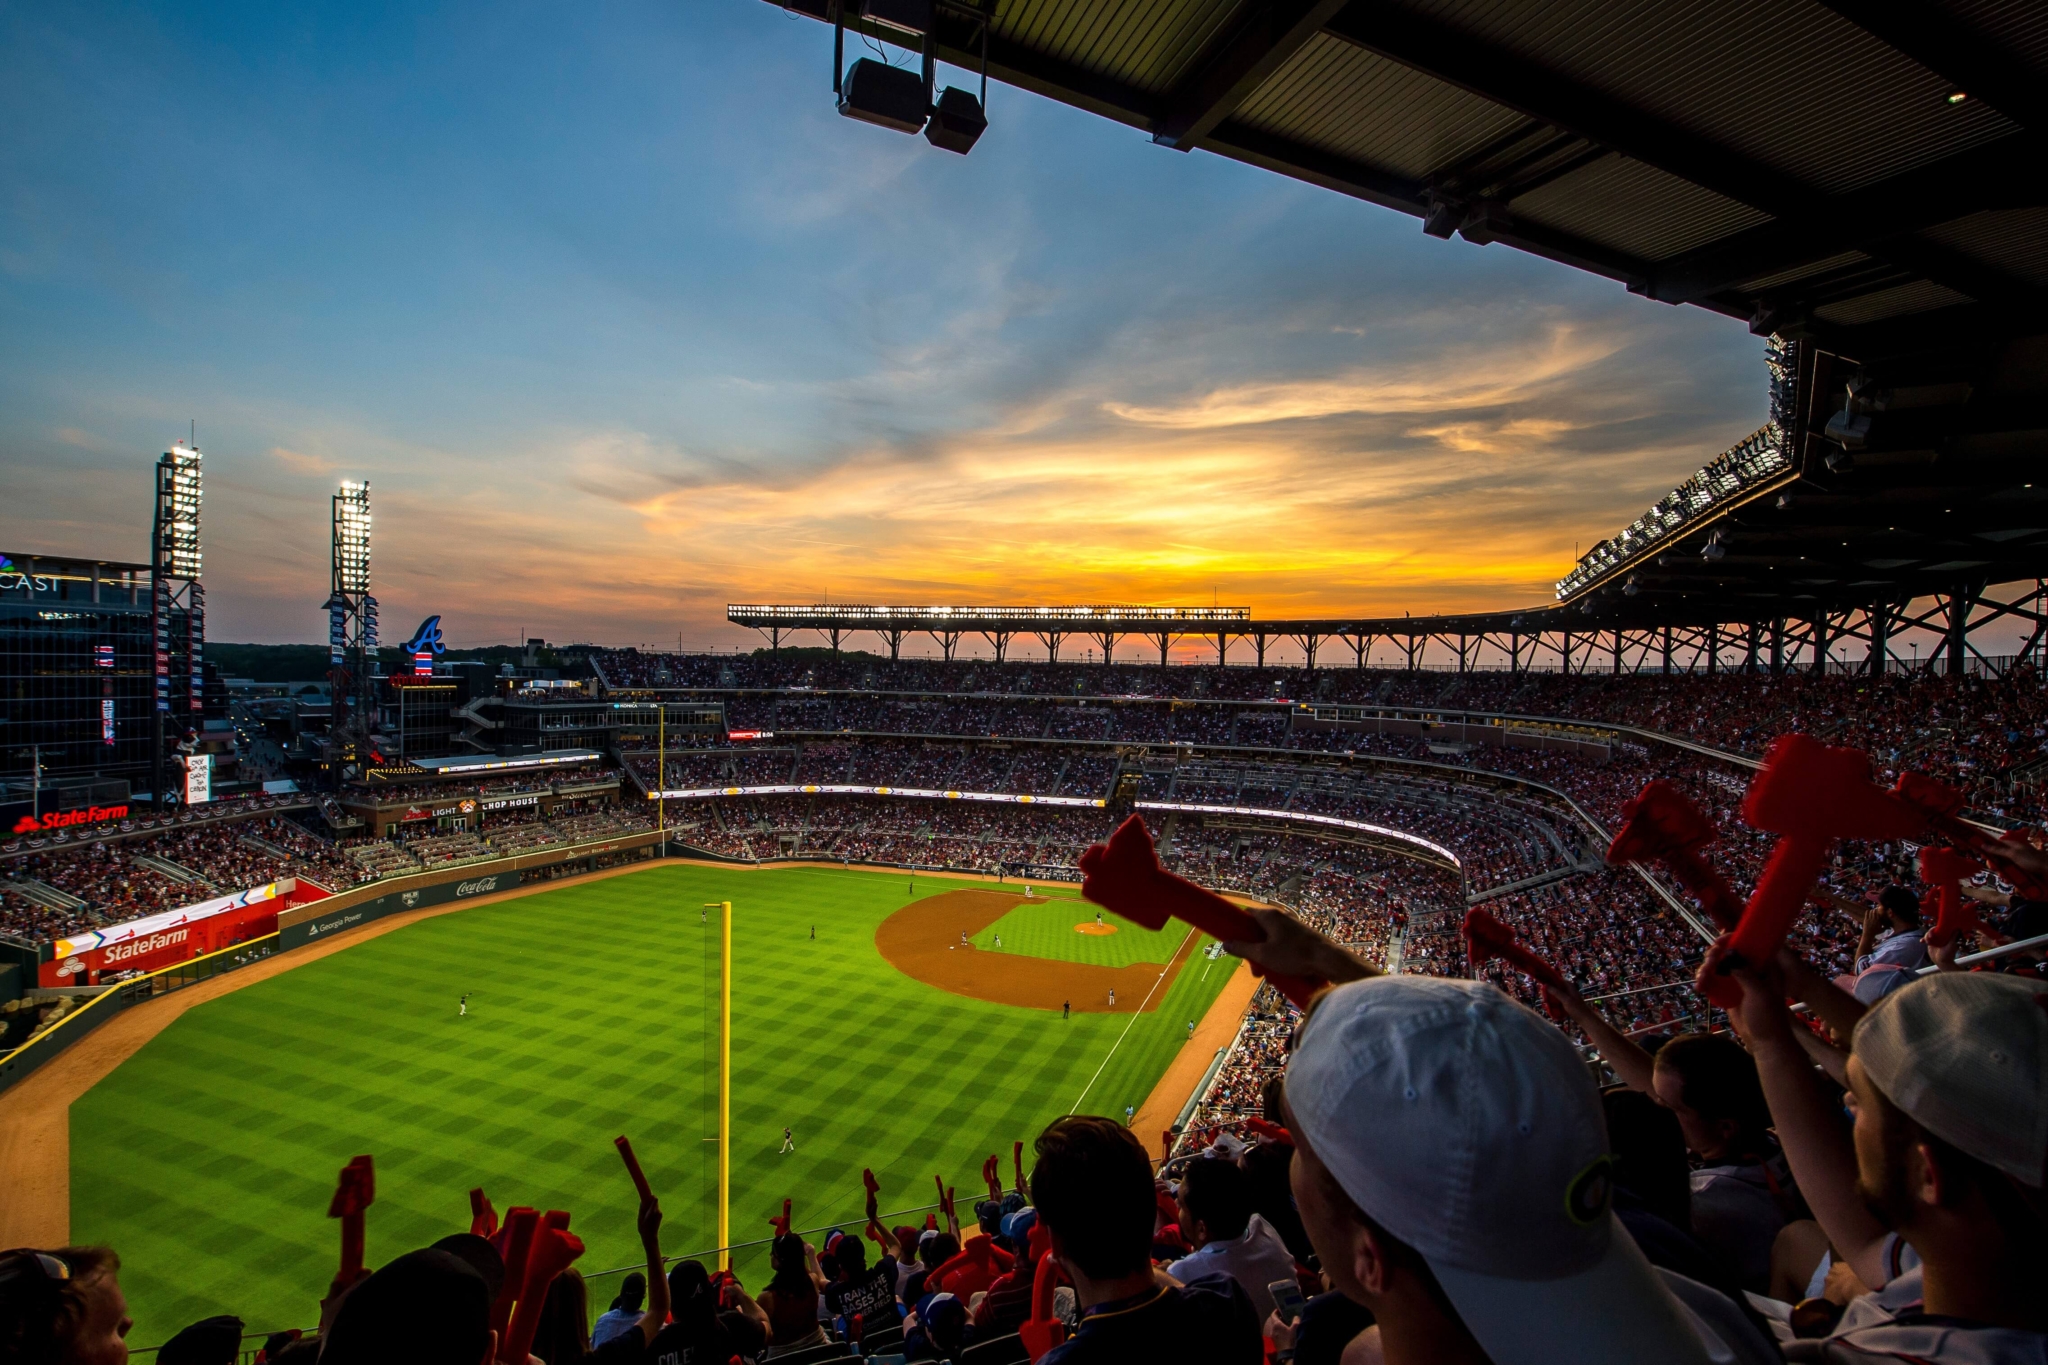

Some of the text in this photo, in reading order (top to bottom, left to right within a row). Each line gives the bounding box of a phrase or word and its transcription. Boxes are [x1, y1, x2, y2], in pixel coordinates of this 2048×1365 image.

[432, 807, 456, 817] LIGHT
[482, 797, 538, 810] CHOP HOUSE
[320, 913, 362, 932] Georgia Power
[844, 1286, 866, 1304] RAN
[869, 1273, 887, 1291] THE
[842, 1283, 889, 1315] BASES AT
[874, 1294, 892, 1311] FIELD
